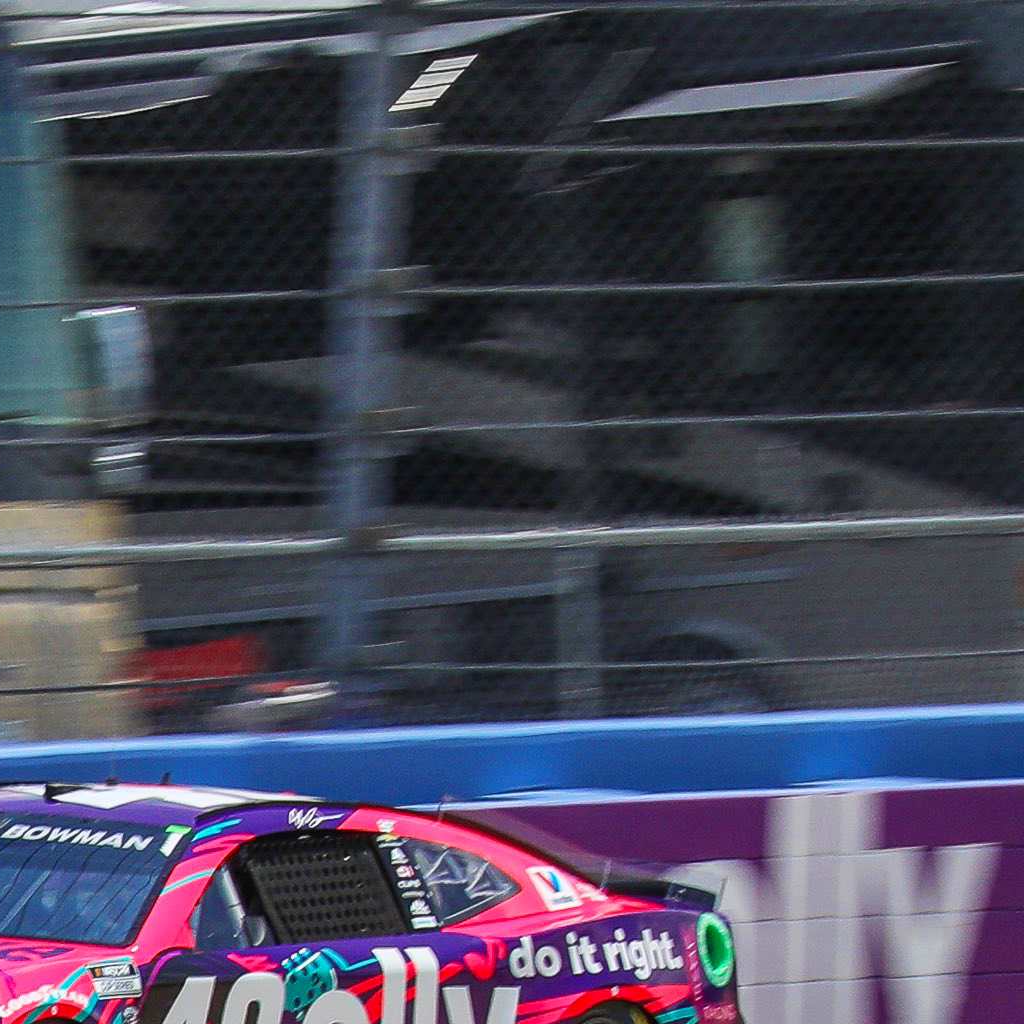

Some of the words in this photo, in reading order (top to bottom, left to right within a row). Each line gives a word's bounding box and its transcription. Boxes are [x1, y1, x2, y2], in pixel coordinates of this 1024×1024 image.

[0, 823, 155, 851] BOWMAN
[508, 935, 562, 979] do
[565, 931, 604, 975] it
[602, 928, 684, 981] right.
